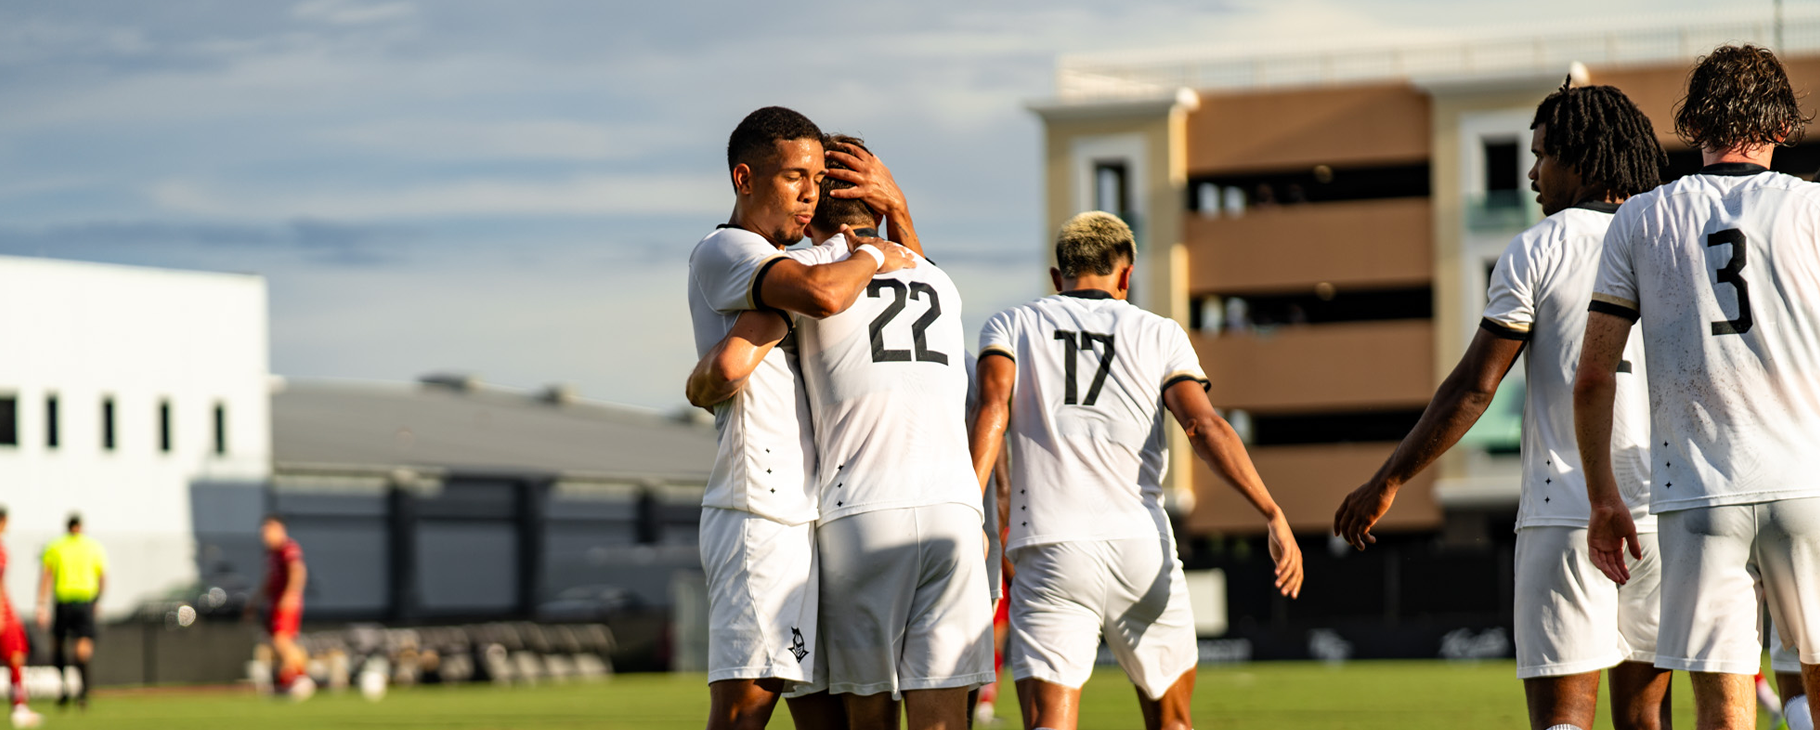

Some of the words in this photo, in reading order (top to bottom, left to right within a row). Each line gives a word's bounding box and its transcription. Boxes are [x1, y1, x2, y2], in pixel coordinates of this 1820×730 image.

[866, 278, 949, 366] 22
[1706, 228, 1754, 336] 3
[1053, 329, 1116, 406] 17
